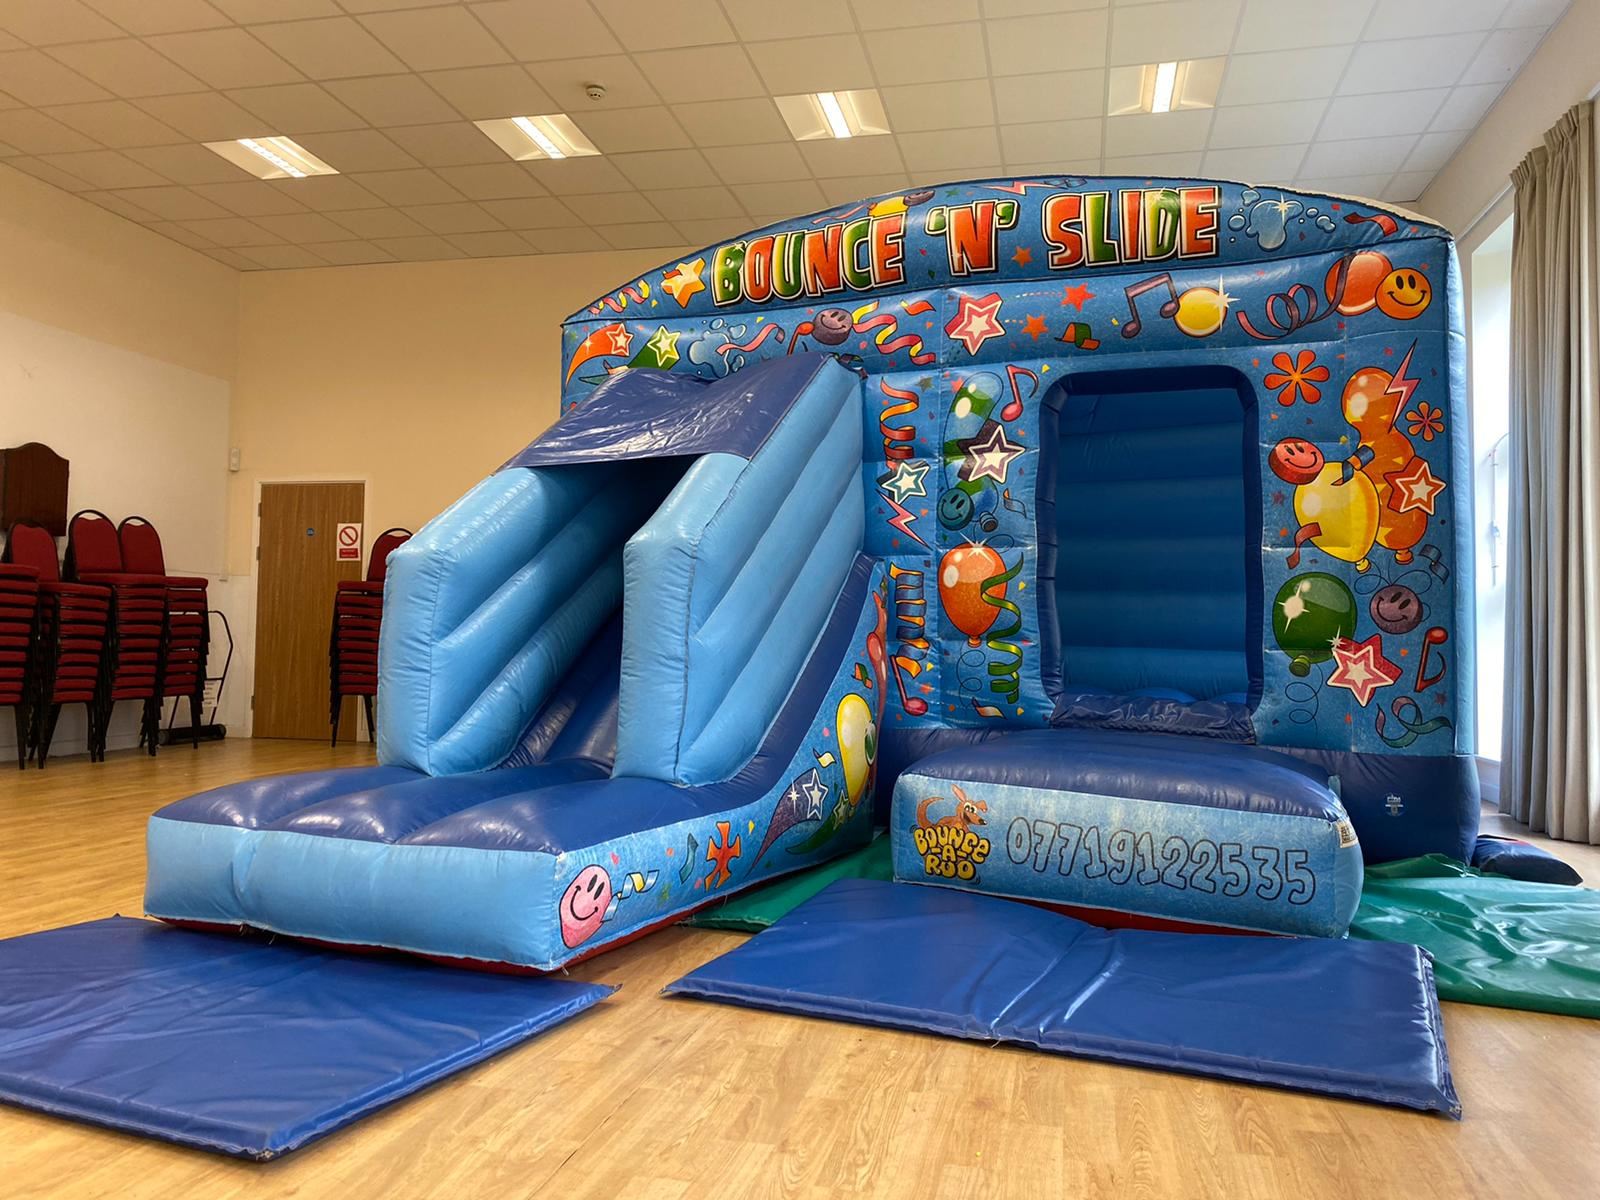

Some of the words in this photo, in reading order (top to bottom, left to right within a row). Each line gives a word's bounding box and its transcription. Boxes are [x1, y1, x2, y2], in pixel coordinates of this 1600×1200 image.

[713, 210, 906, 307] BOUNCE
[1044, 186, 1221, 271] SLIDE
[1006, 816, 1316, 905] 07719122535
